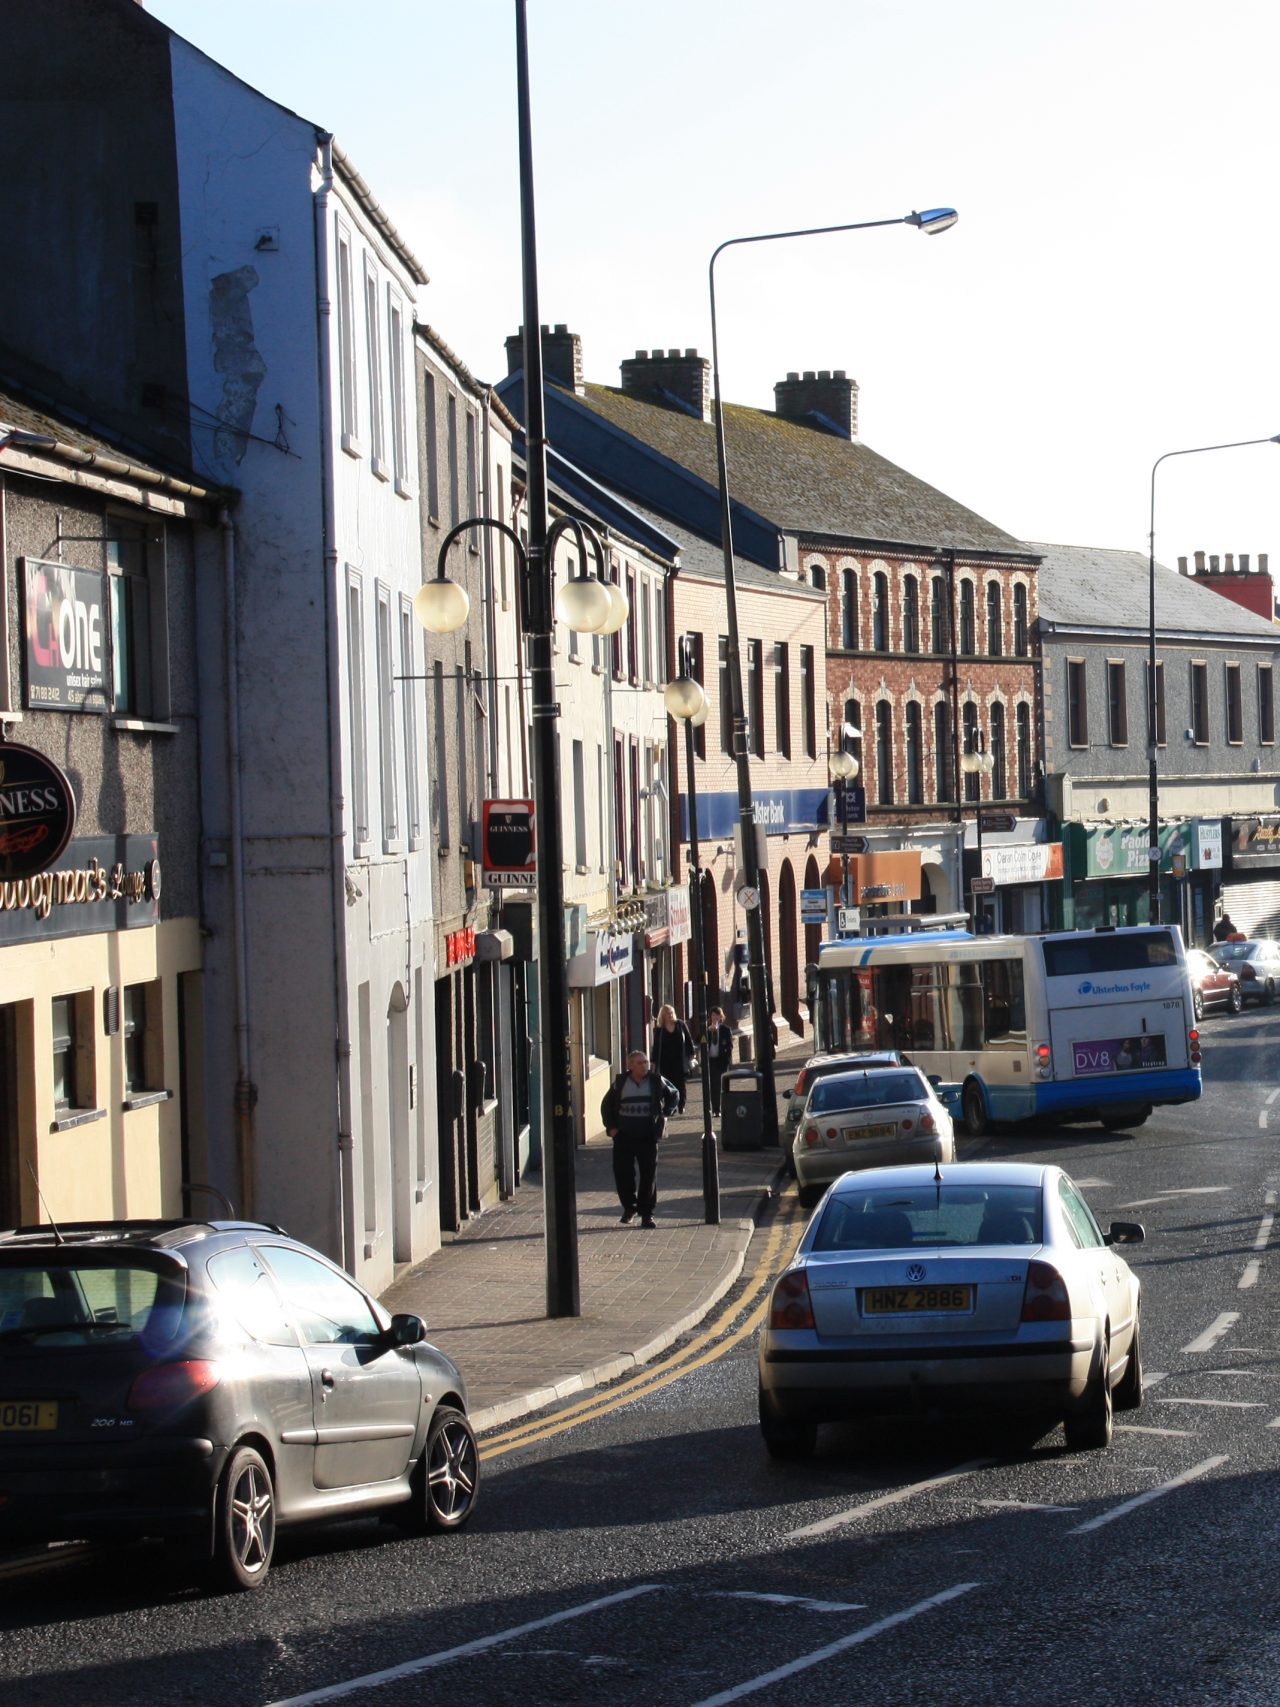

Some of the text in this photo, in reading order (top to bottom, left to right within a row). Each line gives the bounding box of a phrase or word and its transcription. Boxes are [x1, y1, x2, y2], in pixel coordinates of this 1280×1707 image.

[770, 800, 784, 823] Bank
[489, 825, 529, 833] GUINNESS
[1126, 850, 1150, 867] Pizz
[488, 873, 537, 884] GUINNE
[1092, 981, 1151, 994] Ulsterbus Foyle
[1076, 1051, 1110, 1069] DV8
[871, 1291, 963, 1310] HNZ 2886
[91, 1418, 116, 1428] 206
